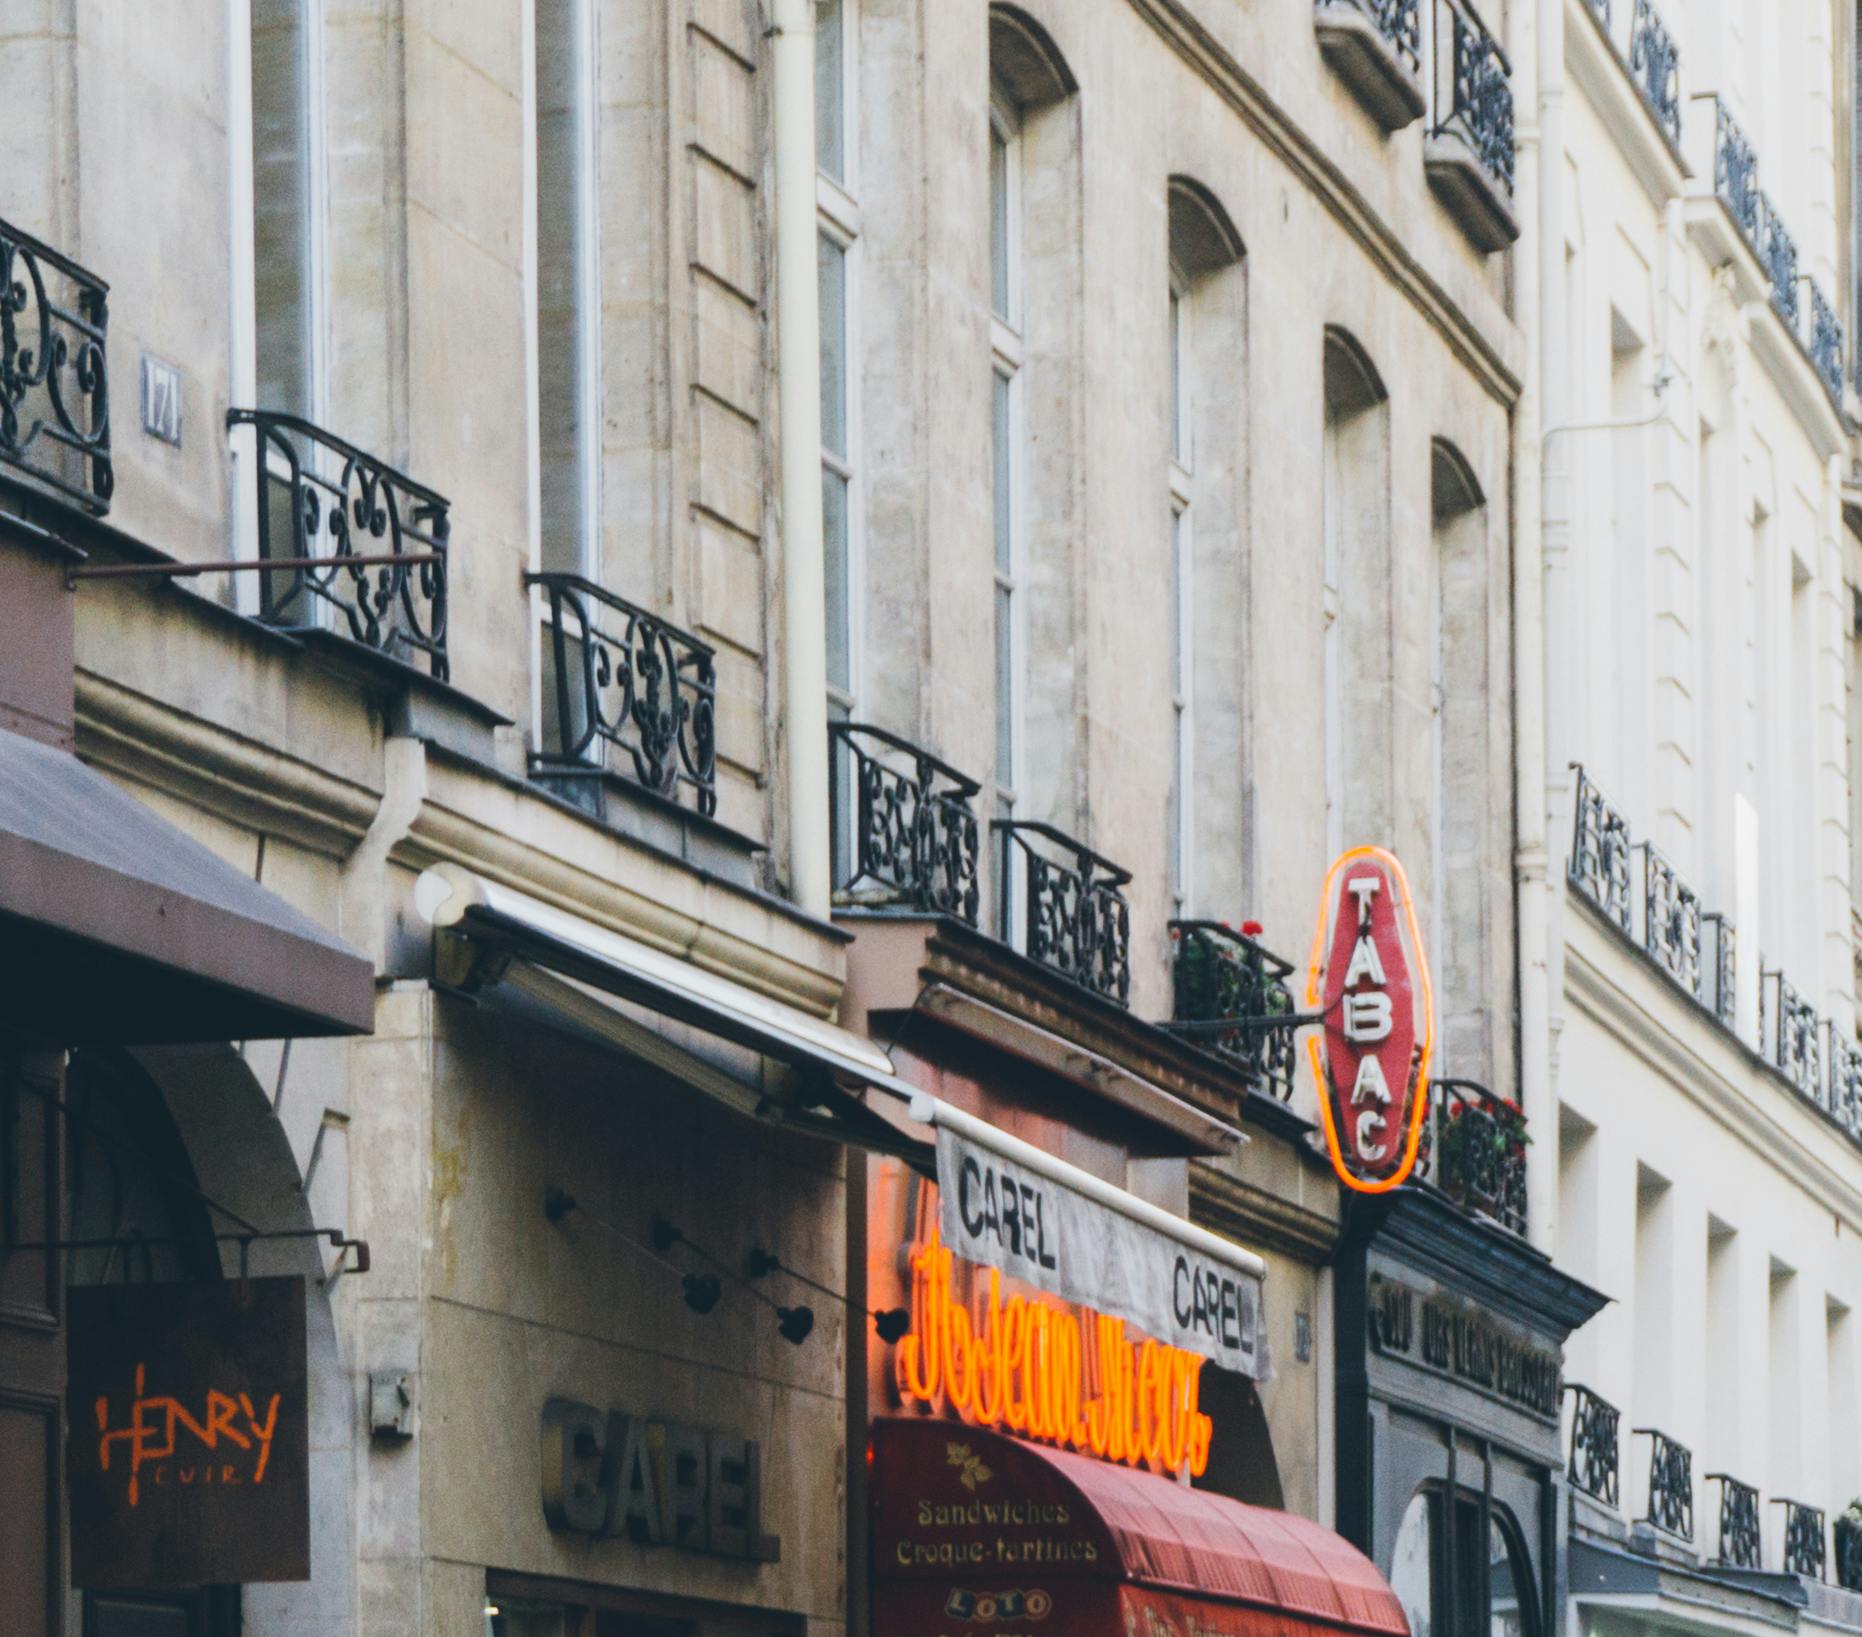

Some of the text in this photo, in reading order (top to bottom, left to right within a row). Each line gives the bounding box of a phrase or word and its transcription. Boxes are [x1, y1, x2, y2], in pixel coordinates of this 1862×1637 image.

[1344, 876, 1393, 1161] TABAC
[958, 1153, 1057, 1271] CAREL
[1172, 1254, 1253, 1357] CAREL
[96, 1361, 281, 1508] HENRY
[154, 1464, 244, 1487] CUIR
[541, 1396, 781, 1562] CAREL
[896, 1537, 1098, 1566] Croque-tartines
[917, 1498, 1070, 1528] Sandwiches
[947, 1589, 1050, 1622] LOTO
